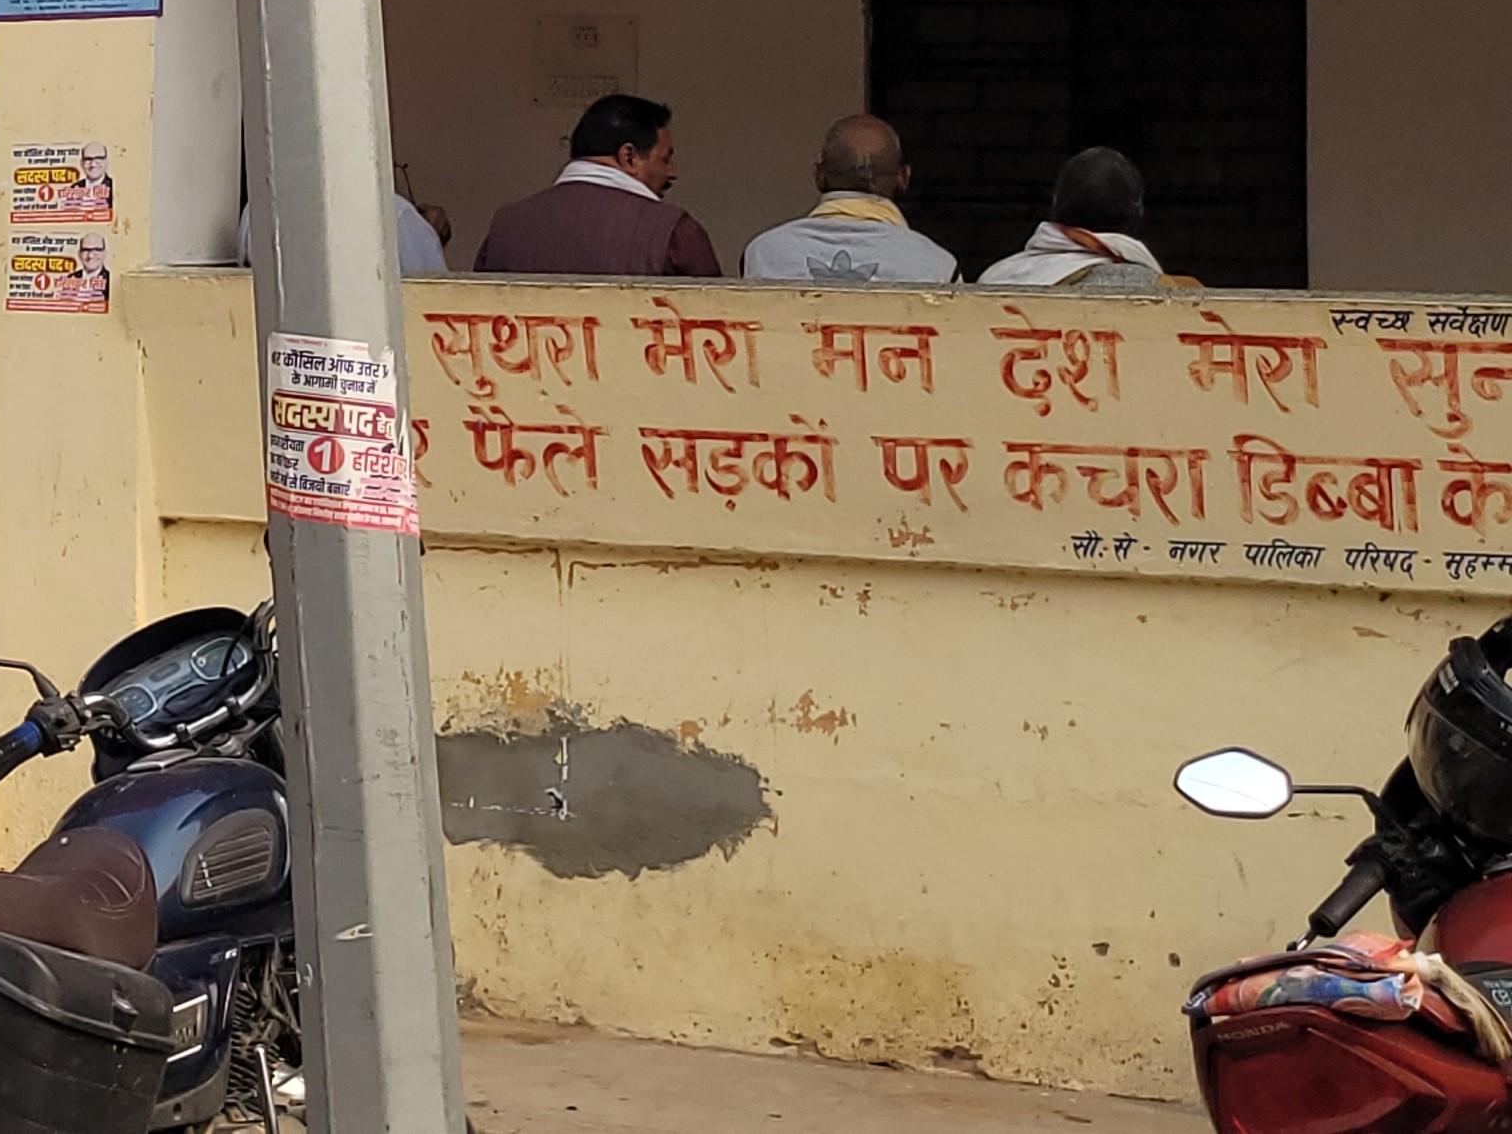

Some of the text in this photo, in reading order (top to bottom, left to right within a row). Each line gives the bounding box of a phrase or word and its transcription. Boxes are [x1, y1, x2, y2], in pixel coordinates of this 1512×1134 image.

[327, 353, 356, 375] ऑफ
[423, 312, 602, 400] सुथरा
[630, 296, 764, 394] मेरा
[801, 321, 940, 396] मन
[990, 304, 1125, 417] देश
[1178, 310, 1329, 413] मेरा
[291, 369, 301, 385] के
[302, 374, 338, 390] आगामी
[272, 395, 340, 432] सदस्य
[341, 405, 376, 437] पद
[314, 440, 332, 472] 1
[462, 403, 610, 498] फैले
[638, 413, 839, 512] सड़कों
[870, 435, 975, 513] पर
[1002, 440, 1210, 527] कचरा
[1226, 433, 1423, 535] डिब्बा
[1168, 540, 1227, 564] नगर
[1243, 538, 1326, 568] पालिका
[1344, 542, 1418, 581] परिषद
[1217, 1020, 1291, 1043] HONDA
